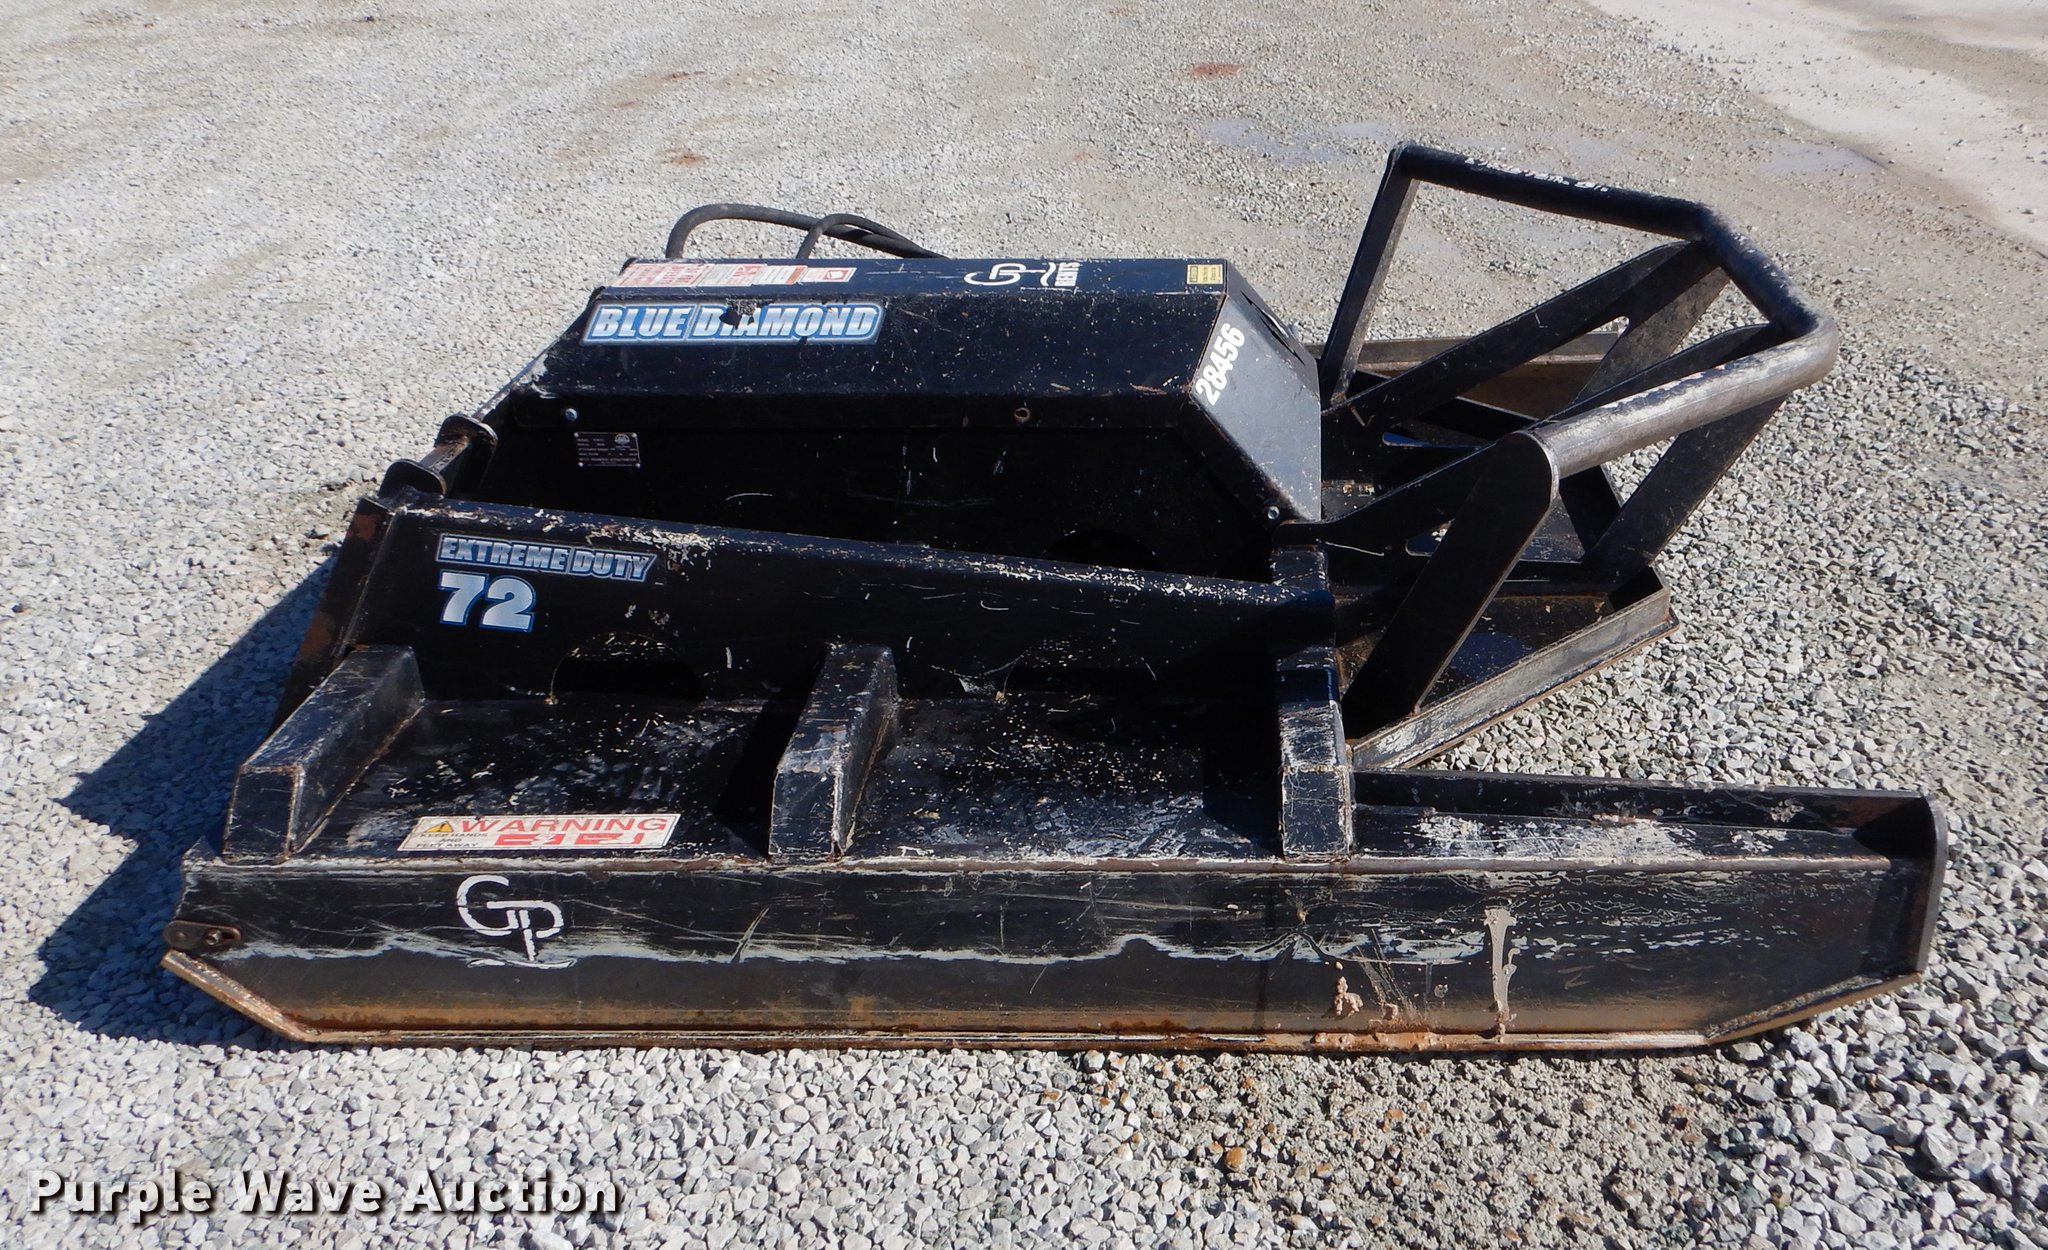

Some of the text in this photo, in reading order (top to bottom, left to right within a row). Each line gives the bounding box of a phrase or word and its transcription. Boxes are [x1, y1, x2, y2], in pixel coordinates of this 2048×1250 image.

[590, 306, 692, 338] BLUE
[1195, 322, 1246, 406] 28456
[440, 537, 650, 579] EXTREME DUTY
[440, 571, 536, 632] 72
[460, 818, 668, 832] WARNING
